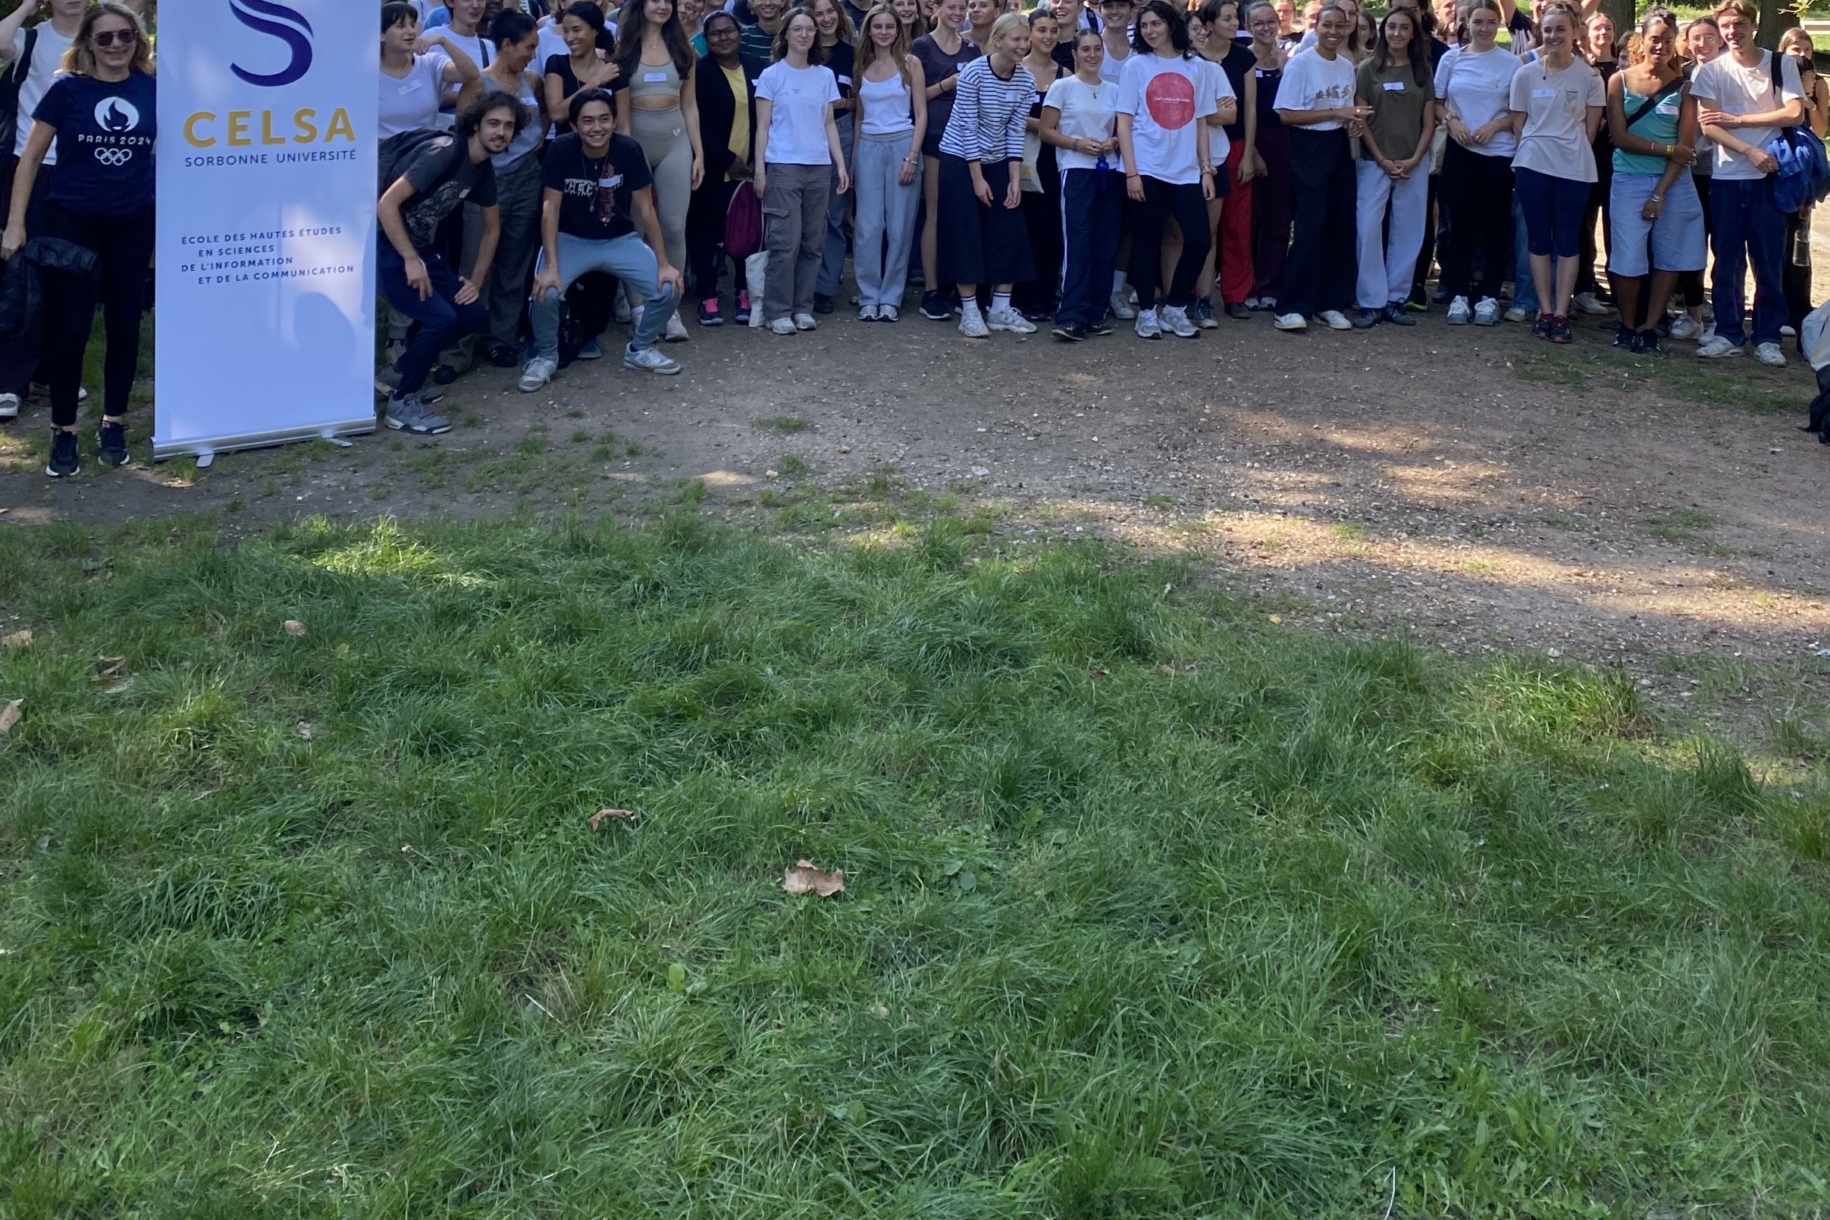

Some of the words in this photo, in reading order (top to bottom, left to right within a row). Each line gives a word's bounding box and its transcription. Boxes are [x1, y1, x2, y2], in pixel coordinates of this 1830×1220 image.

[183, 107, 356, 148] CELSA
[78, 133, 116, 144] PARIS
[119, 136, 151, 146] 2024
[184, 153, 268, 167] SORBONNE
[276, 148, 357, 164] UNIVERSITÉ
[181, 235, 220, 245] ÉCOLE
[224, 233, 246, 242] DES
[250, 230, 295, 240] HAUTES
[299, 226, 342, 237] ÉTUDES
[198, 249, 213, 257] EN
[218, 245, 275, 256] SCIENCES
[181, 264, 196, 272] DE
[200, 256, 293, 271] L'INFORMATION
[198, 276, 212, 284] ET
[216, 274, 230, 283] DE
[235, 273, 249, 282] LA
[253, 265, 354, 280] COMMUNICATION
